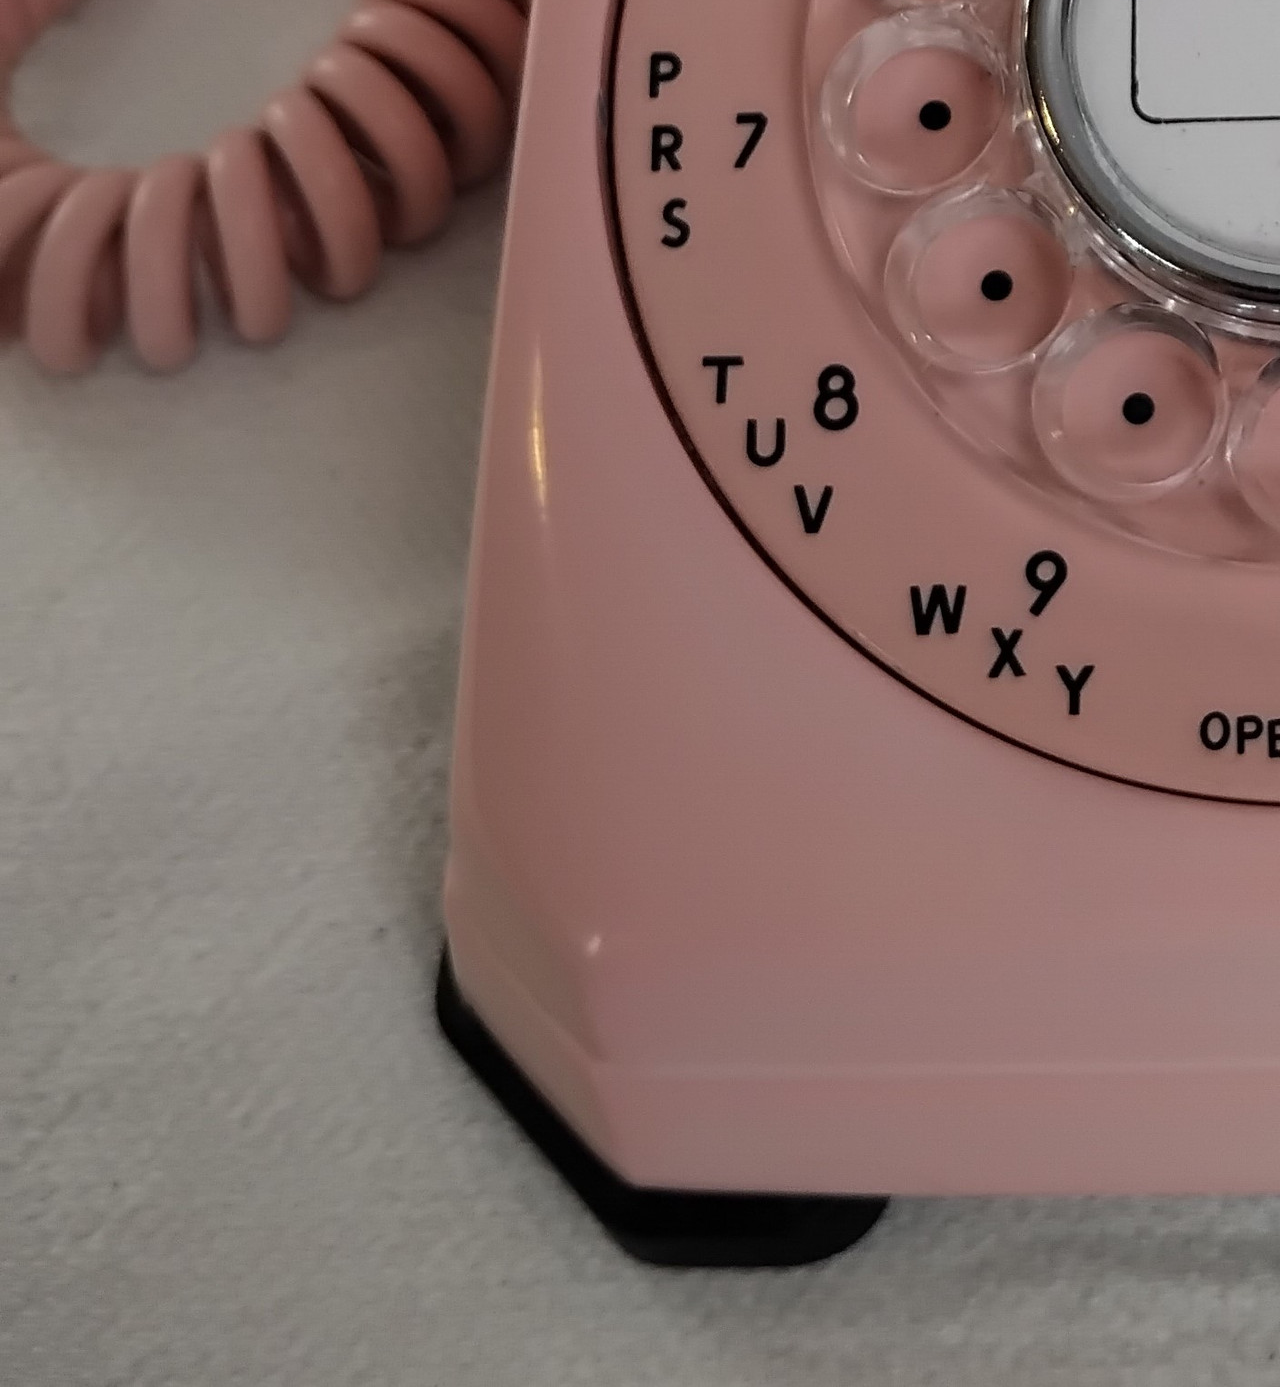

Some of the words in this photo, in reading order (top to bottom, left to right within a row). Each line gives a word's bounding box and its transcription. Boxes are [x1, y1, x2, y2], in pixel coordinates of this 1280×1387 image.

[648, 50, 684, 102] P
[648, 122, 685, 175] R
[731, 110, 770, 172] 7
[658, 195, 692, 251] S
[811, 362, 861, 436] 8
[699, 353, 746, 408] T
[741, 416, 788, 472] U
[791, 482, 835, 539] V
[1021, 548, 1070, 620] 9
[907, 582, 969, 639] W
[984, 625, 1029, 683] X
[1053, 663, 1097, 718] Y
